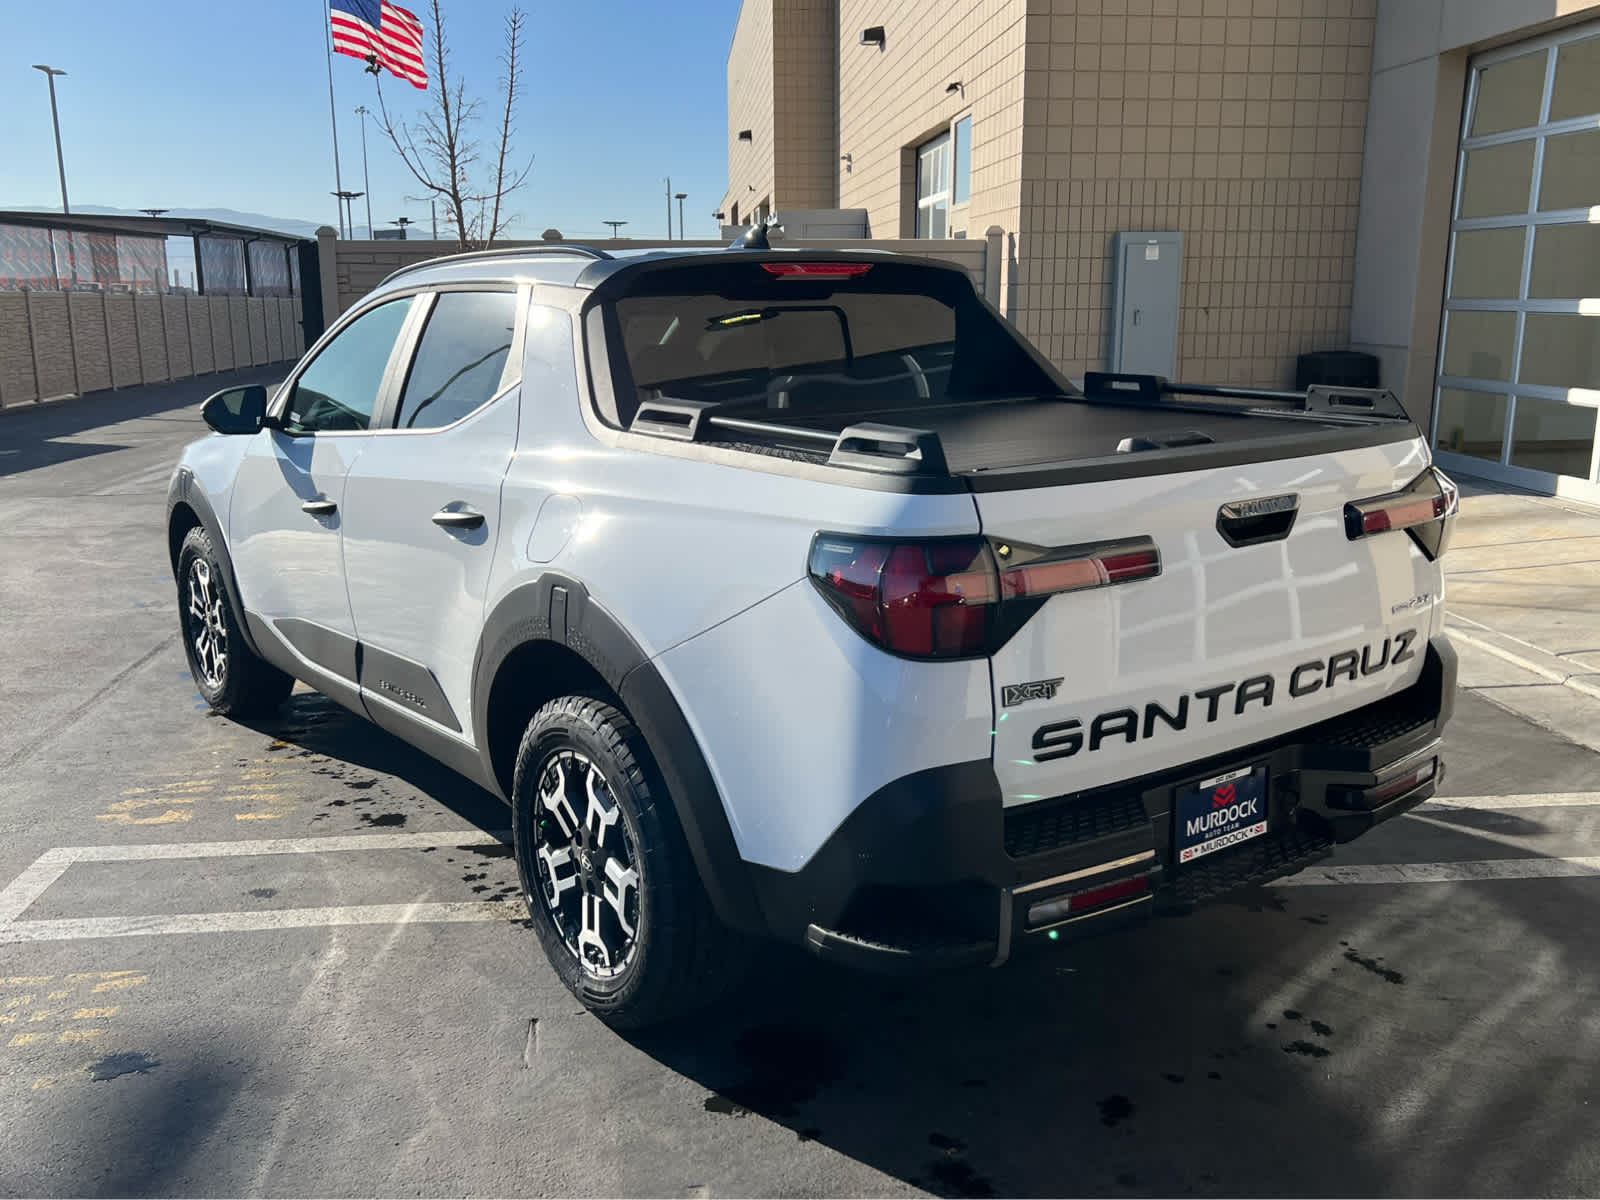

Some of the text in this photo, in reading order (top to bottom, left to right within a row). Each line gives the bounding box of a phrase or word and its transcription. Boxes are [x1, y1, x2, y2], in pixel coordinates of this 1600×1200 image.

[1002, 677, 1064, 707] XRT
[1031, 629, 1417, 762] SANTA CRUZ
[1186, 797, 1258, 837] MURDOCK
[1200, 829, 1249, 854] MURDOCK
[1205, 828, 1222, 839] AUTO
